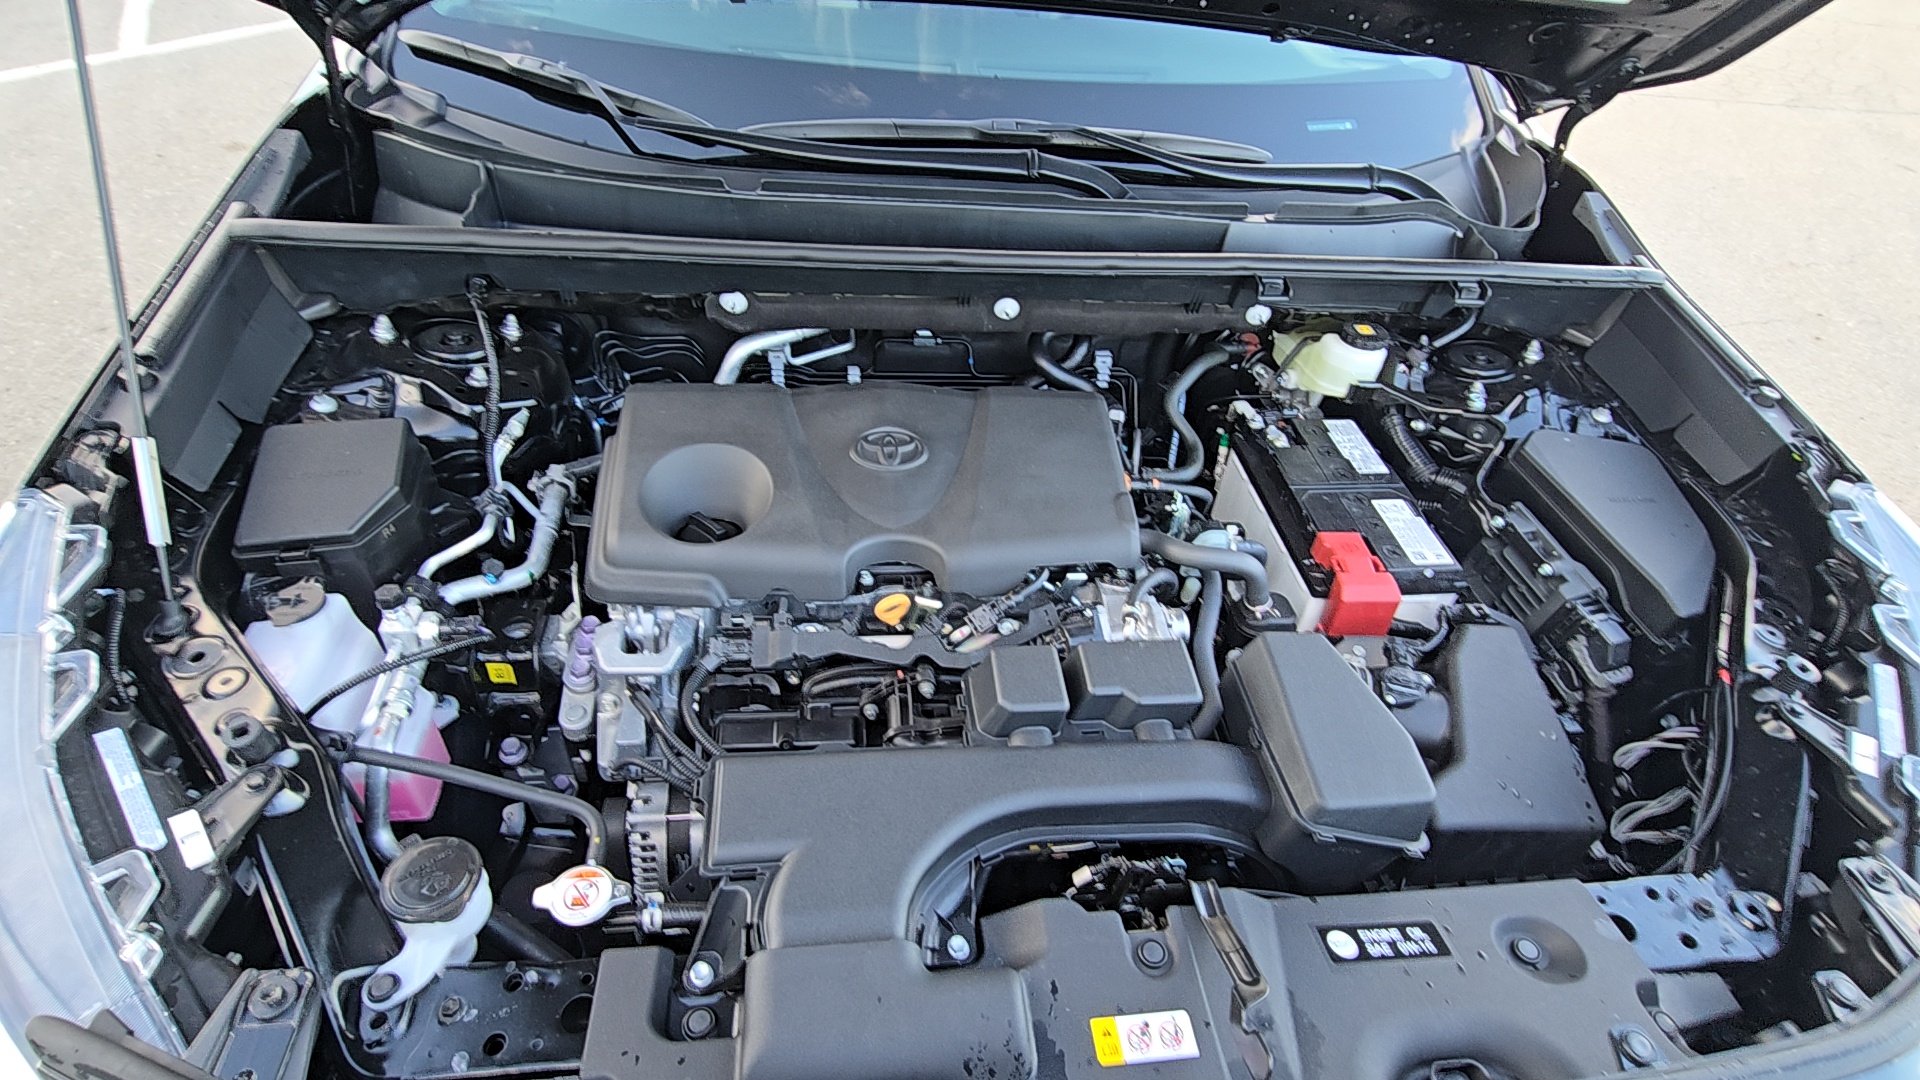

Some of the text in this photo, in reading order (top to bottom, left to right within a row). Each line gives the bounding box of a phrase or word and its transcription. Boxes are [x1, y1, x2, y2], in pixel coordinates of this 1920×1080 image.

[1357, 926, 1431, 943] ENGINE OIL
[1364, 942, 1395, 958] SAE
